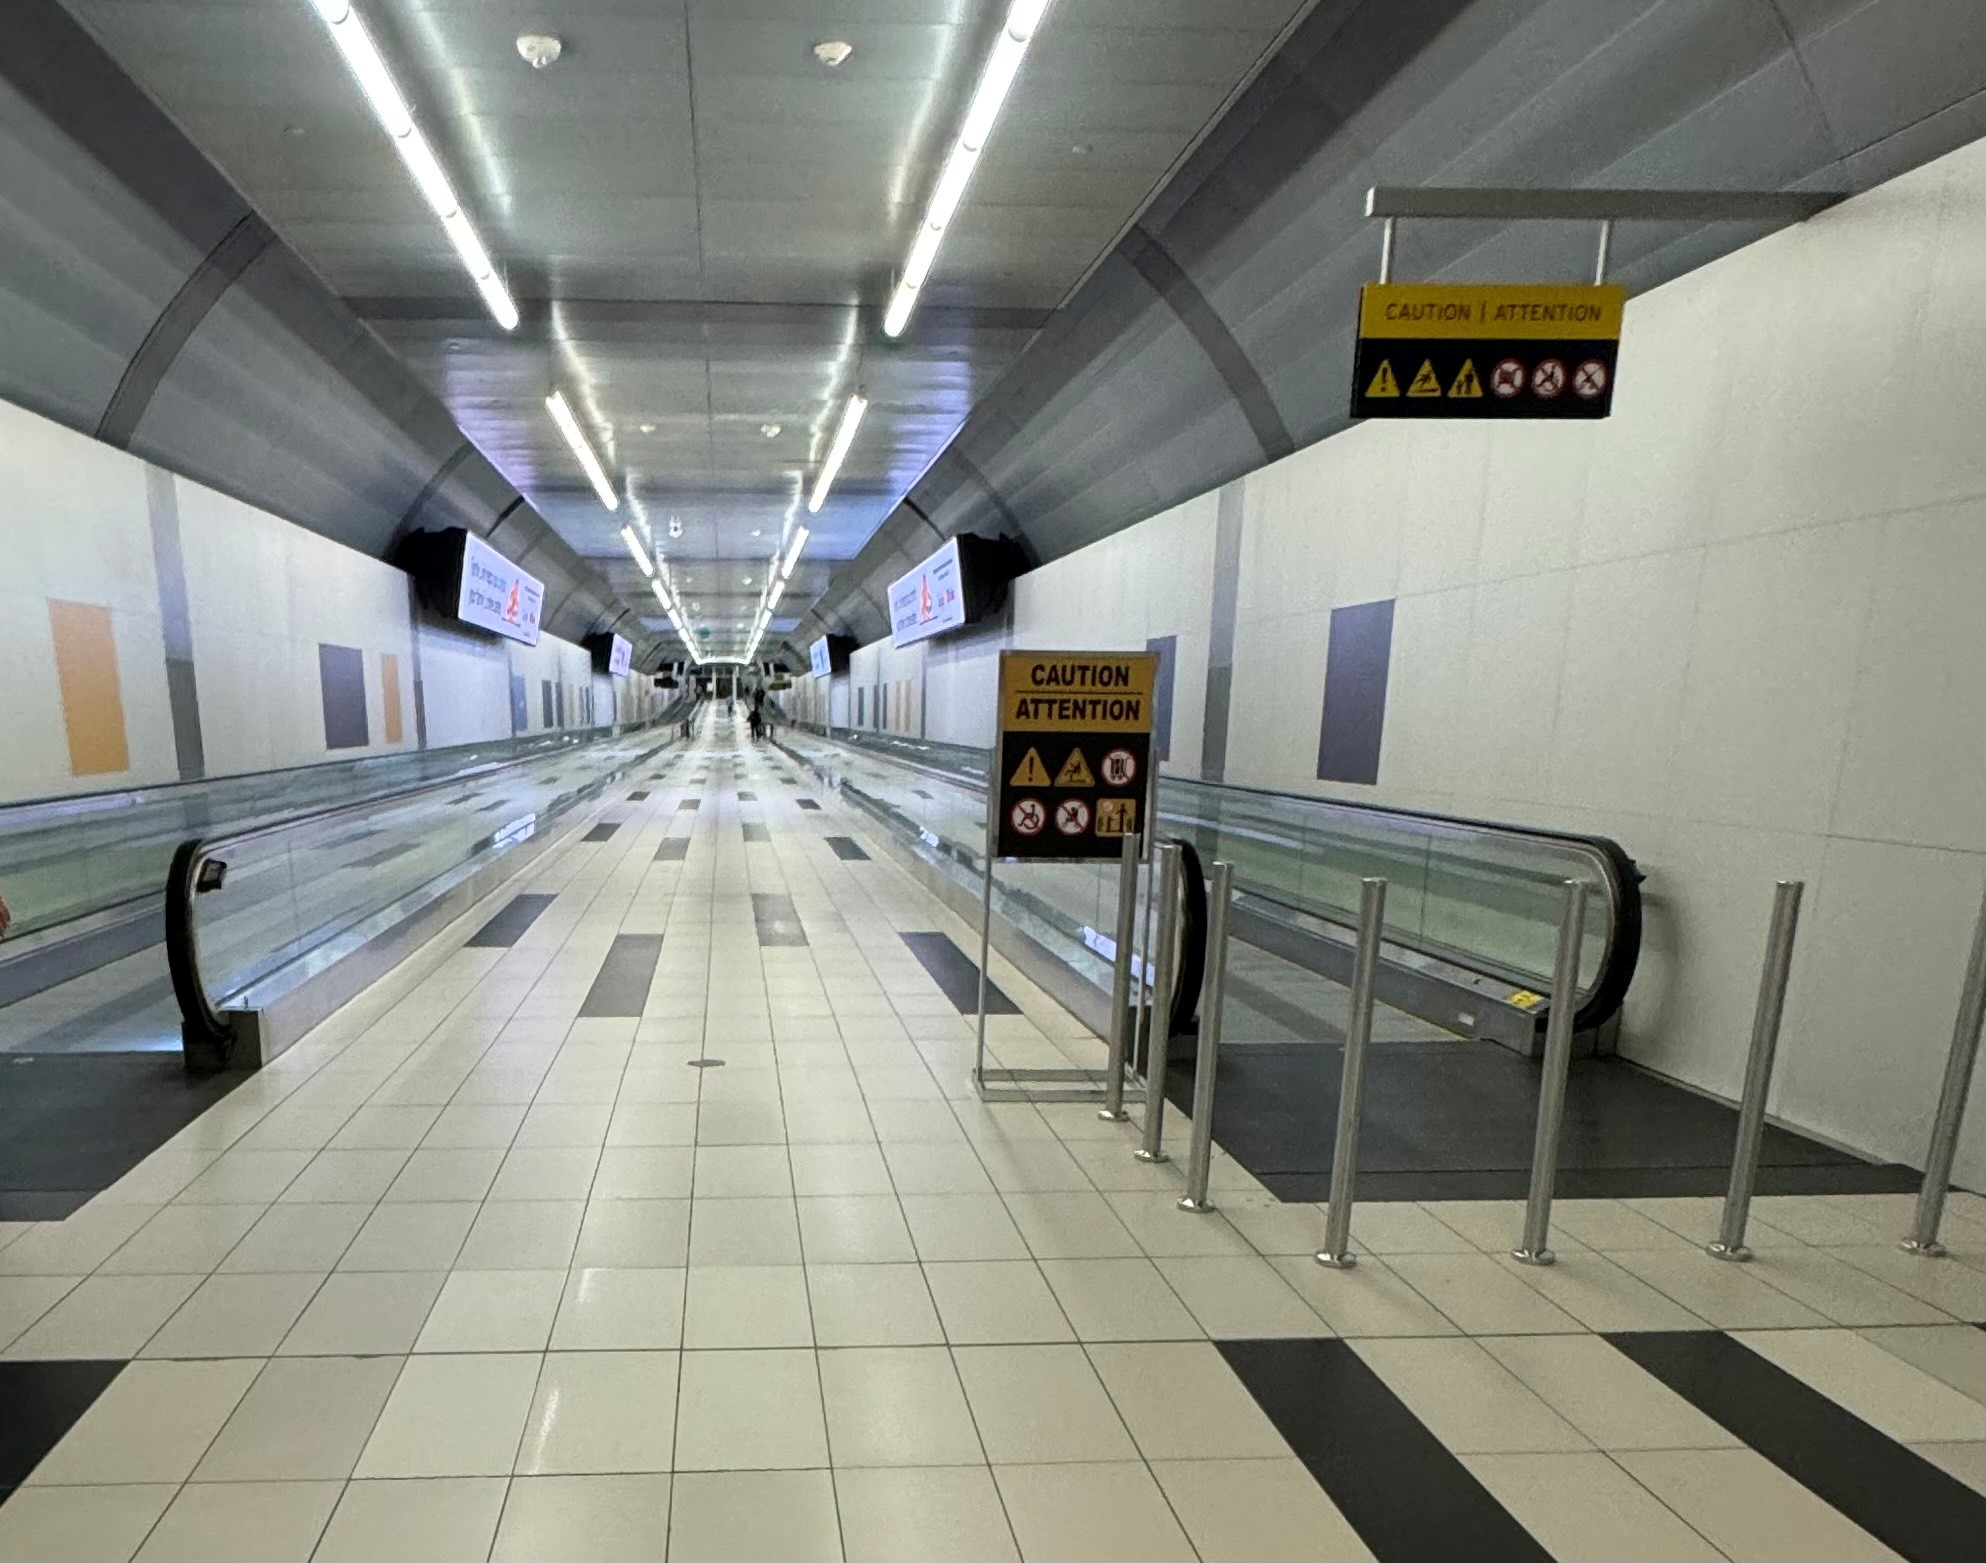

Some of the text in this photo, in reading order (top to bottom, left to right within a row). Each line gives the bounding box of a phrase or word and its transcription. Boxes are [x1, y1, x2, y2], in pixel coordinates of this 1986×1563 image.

[1384, 302, 1601, 322] CAUTION ATTENTION
[1031, 664, 1130, 687] CAUTION
[1015, 697, 1141, 720] ATTENTION
